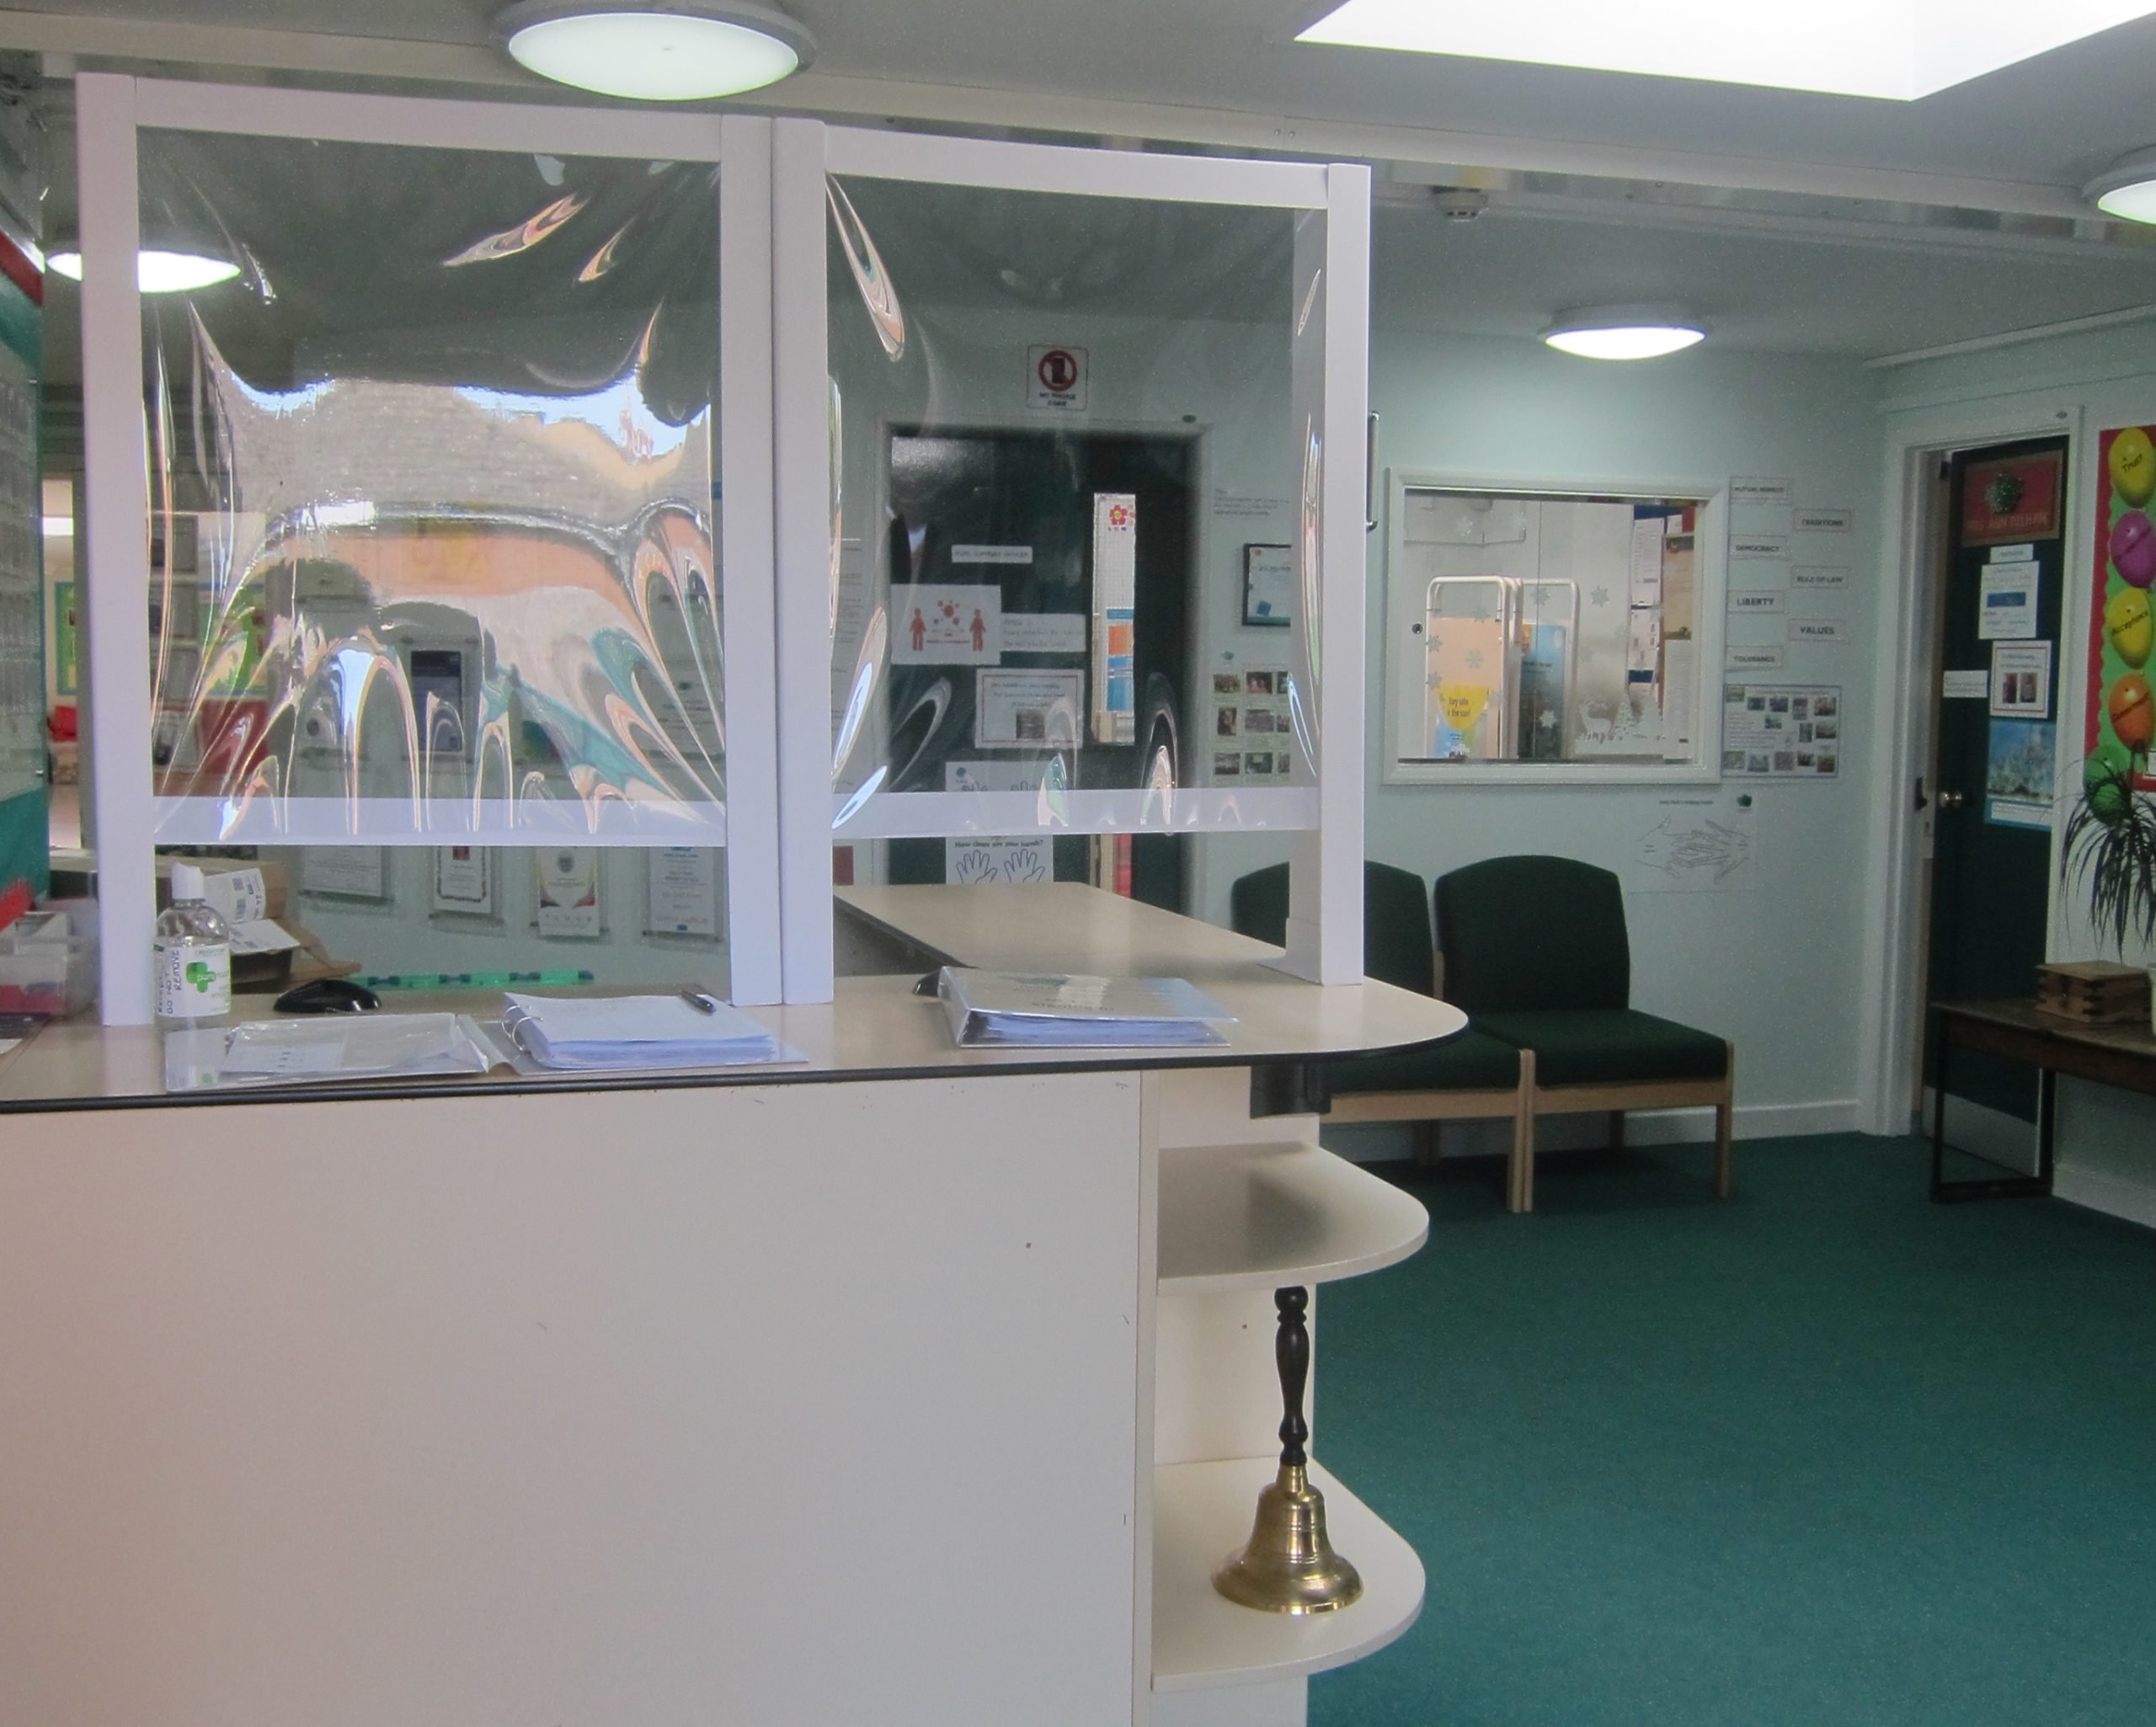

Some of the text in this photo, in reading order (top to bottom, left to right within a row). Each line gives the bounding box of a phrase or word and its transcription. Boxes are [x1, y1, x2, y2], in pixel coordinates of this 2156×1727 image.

[2121, 453, 2143, 473] Trust
[1737, 598, 1774, 606] LIBERTY
[1800, 626, 1834, 635] VALUES
[2111, 609, 2149, 637] Acceptance
[171, 949, 182, 991] REMOVE
[167, 999, 173, 1014] DO
